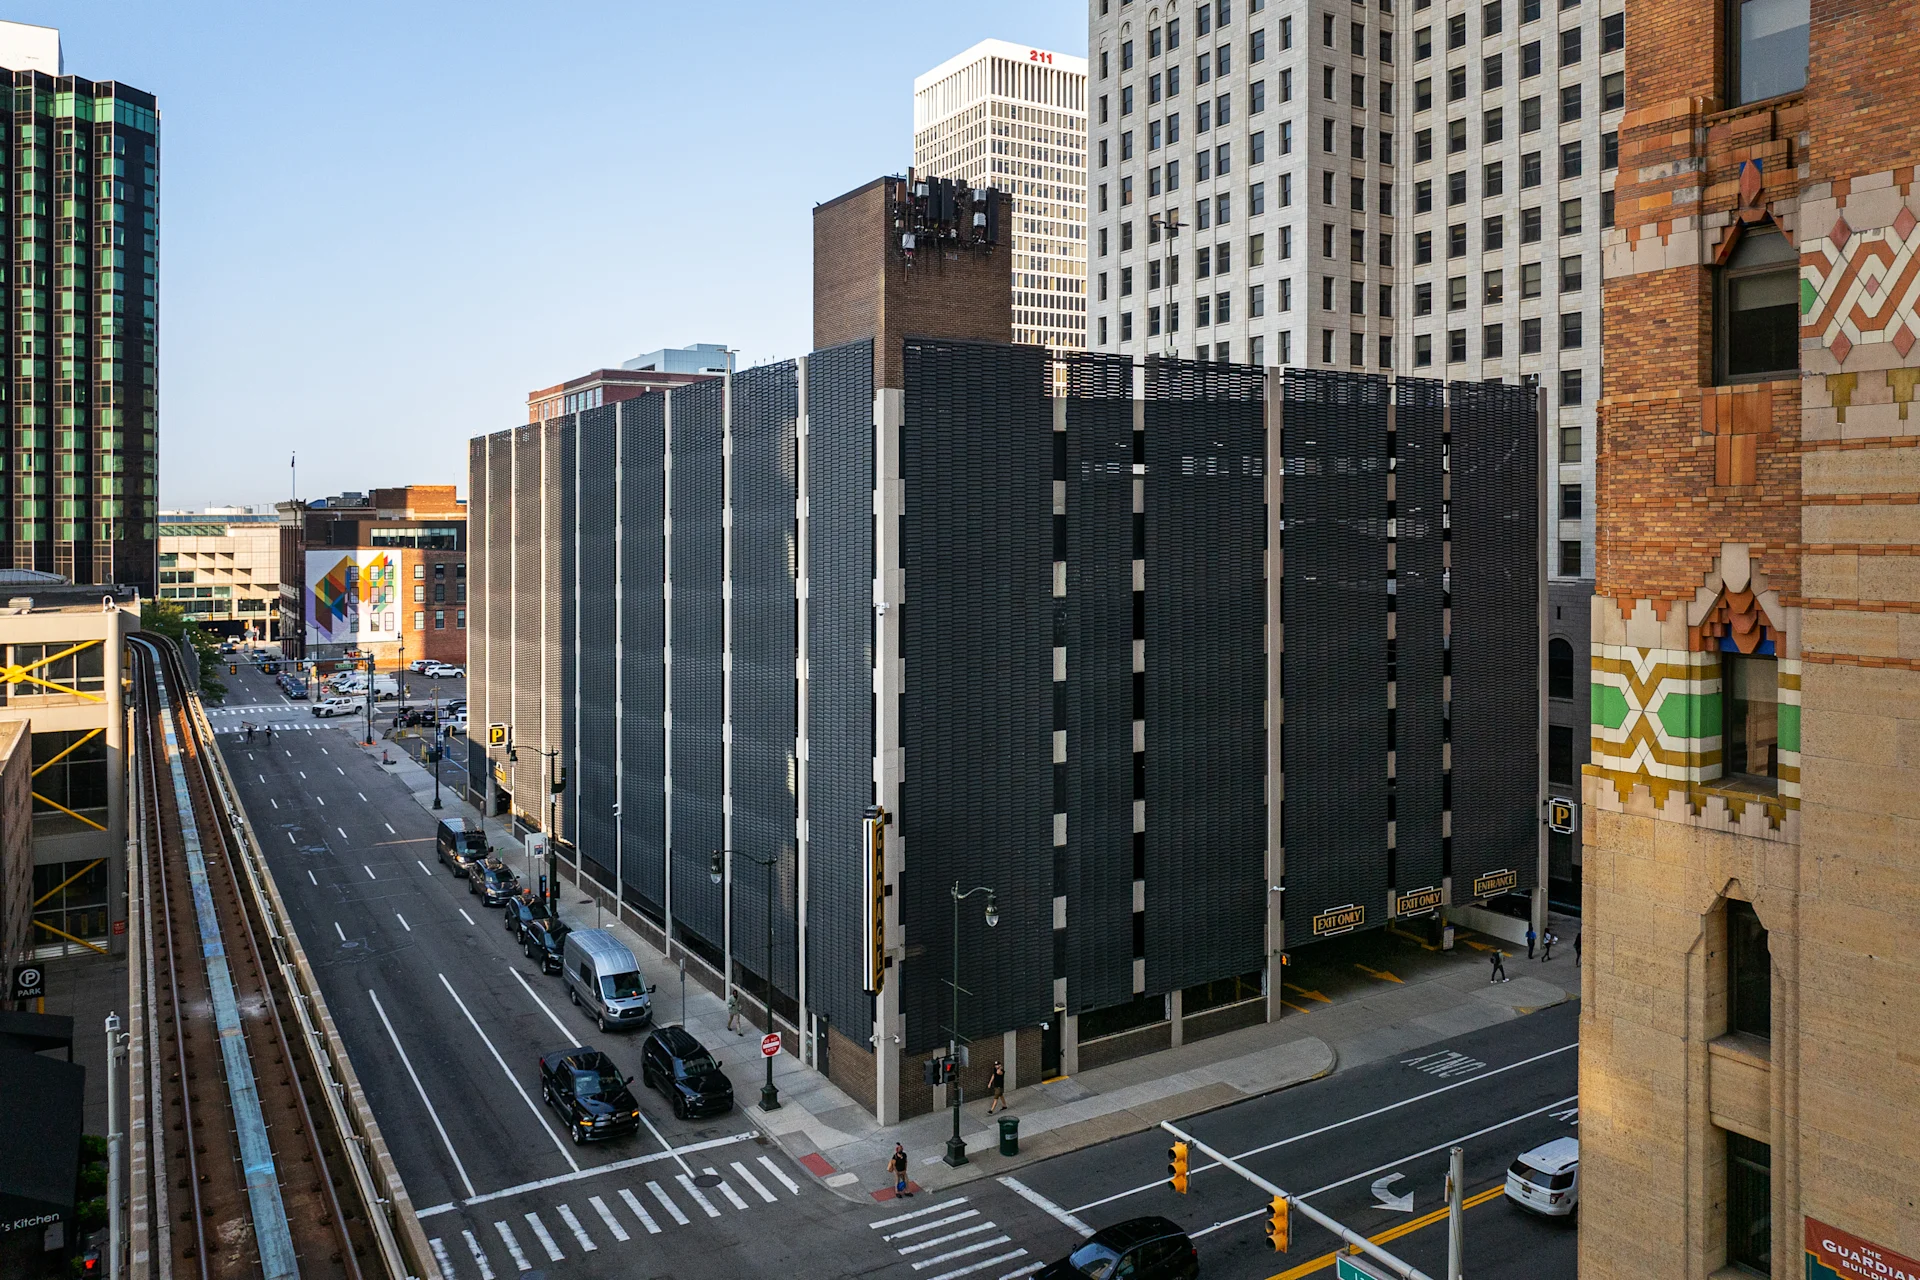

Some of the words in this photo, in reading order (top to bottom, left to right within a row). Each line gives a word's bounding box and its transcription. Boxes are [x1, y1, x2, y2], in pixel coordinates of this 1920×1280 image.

[1030, 50, 1052, 64] 211
[492, 728, 503, 743] P
[1556, 807, 1569, 825] P
[1478, 875, 1514, 892] ENTRANCE
[1401, 898, 1419, 911] EXIT
[1419, 892, 1441, 905] ONLY
[1317, 915, 1338, 930] EXIT
[1337, 910, 1361, 925] ONLY
[17, 988, 41, 997] PARK
[14, 1212, 60, 1230] Kitchen
[1860, 1246, 1882, 1260] THE
